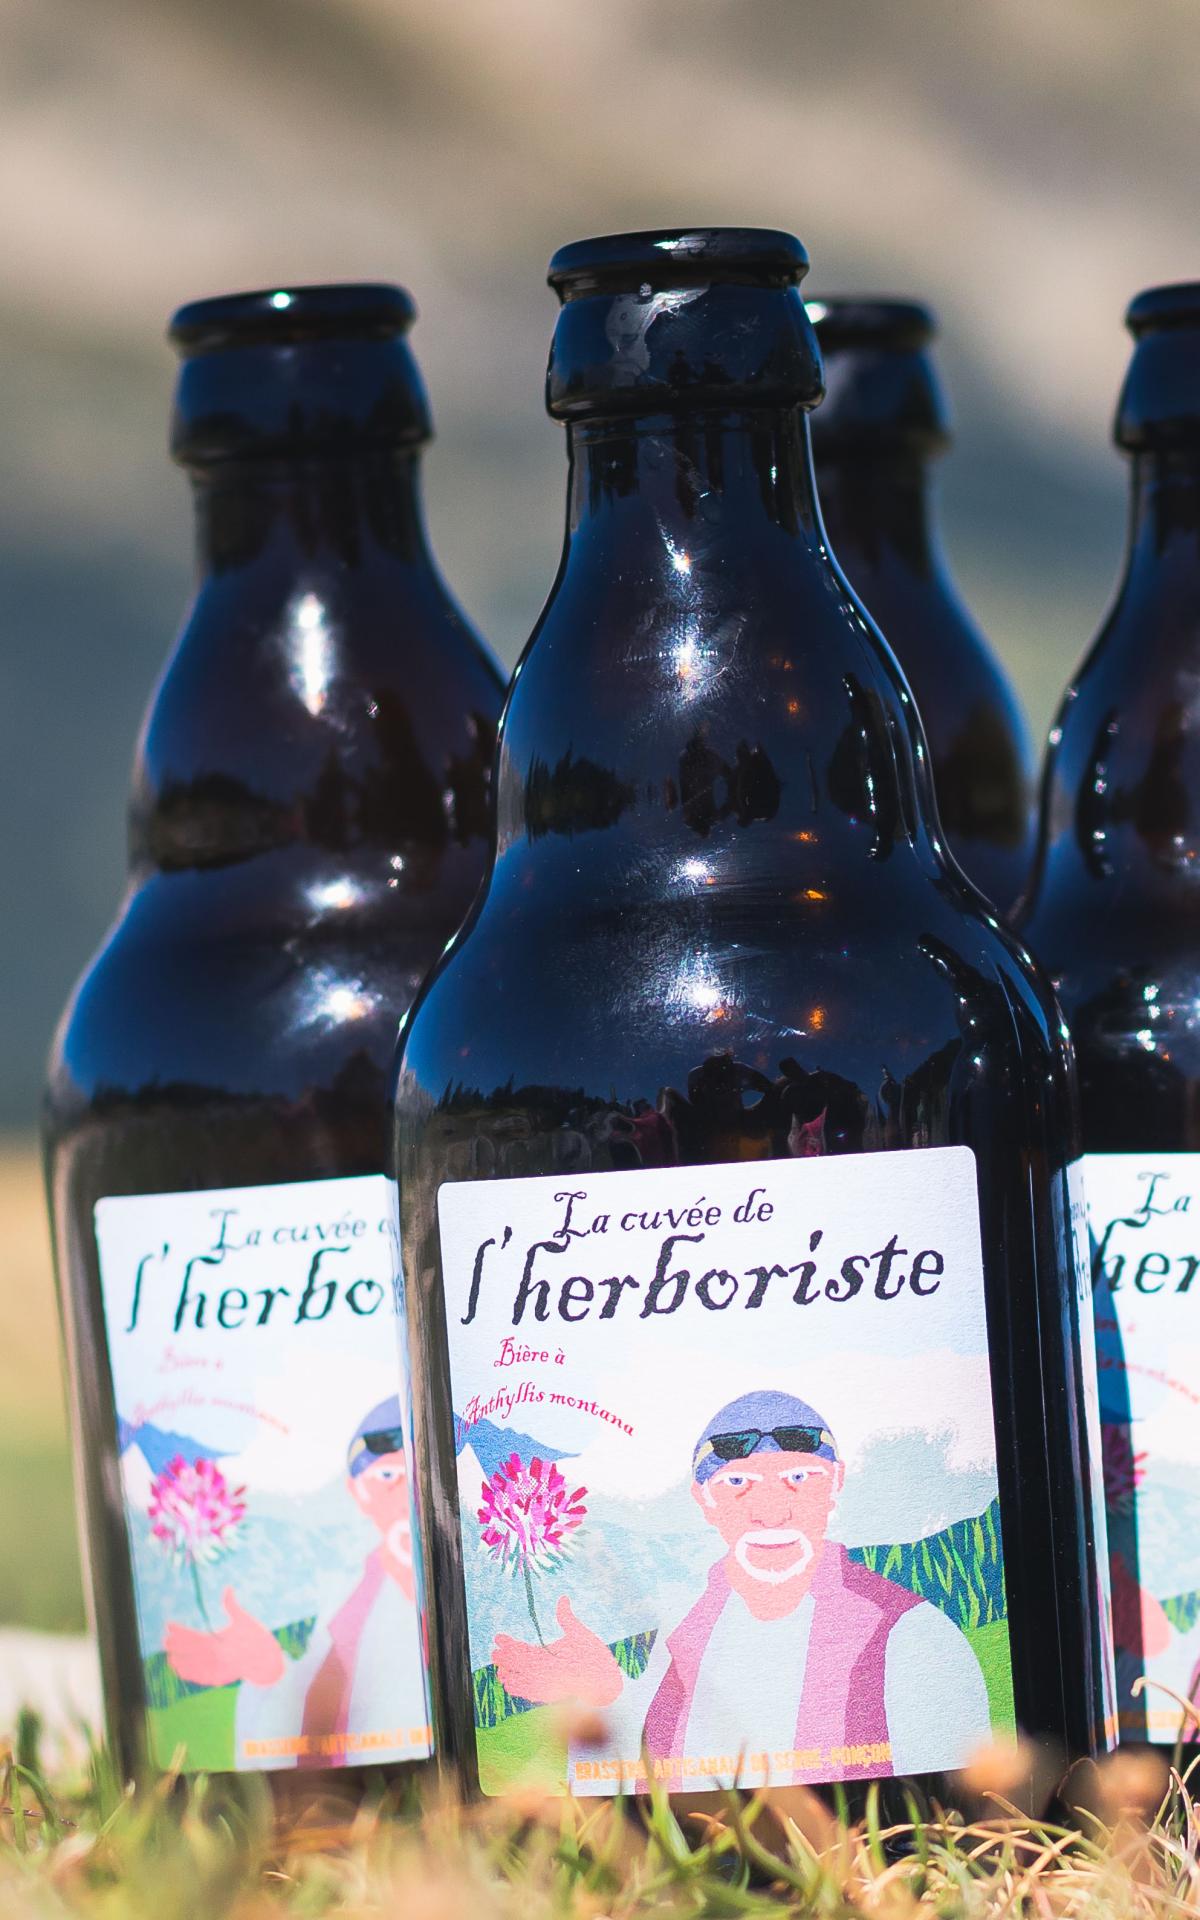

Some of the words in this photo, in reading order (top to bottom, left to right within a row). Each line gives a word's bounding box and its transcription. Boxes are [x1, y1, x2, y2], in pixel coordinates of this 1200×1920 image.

[553, 1190, 610, 1238] La
[620, 1196, 722, 1232] cuvée
[733, 1188, 774, 1224] de
[1137, 1171, 1191, 1215] La
[209, 1208, 262, 1251] La
[272, 1212, 368, 1244] cuvée
[125, 1242, 385, 1333] l'herbo
[460, 1226, 945, 1326] l'herboriste
[493, 1336, 550, 1368] Bière
[554, 1347, 566, 1366] à
[549, 1391, 634, 1437] montana
